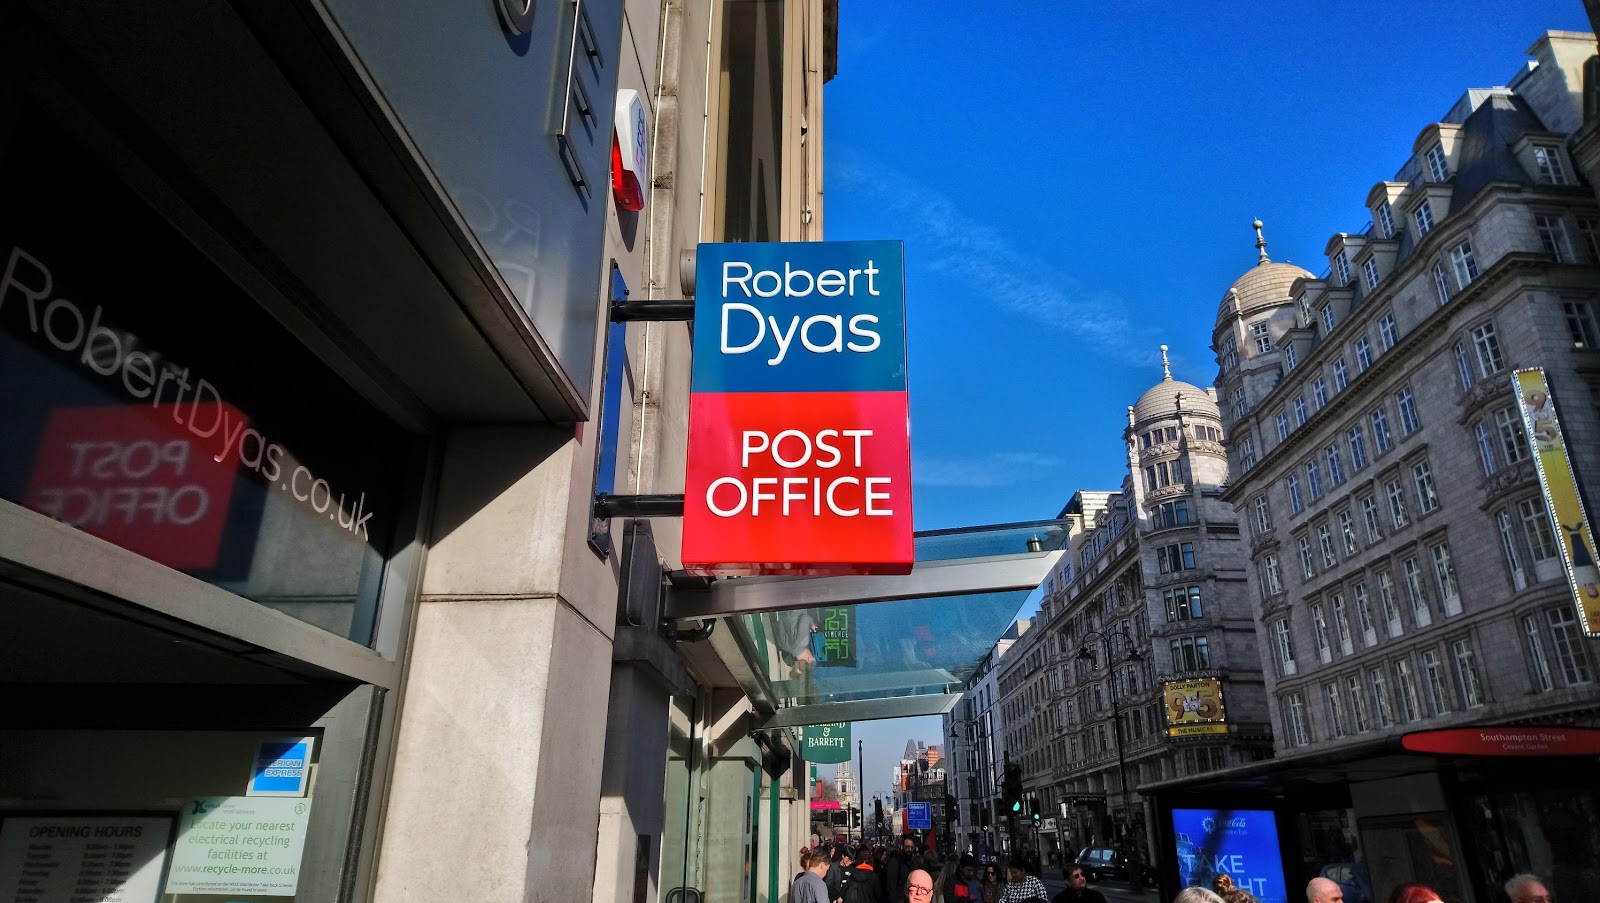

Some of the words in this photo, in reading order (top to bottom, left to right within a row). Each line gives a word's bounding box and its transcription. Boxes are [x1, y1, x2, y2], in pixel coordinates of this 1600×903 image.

[722, 260, 880, 298] Robert
[720, 303, 881, 366] Dyas
[0, 246, 373, 541] RobertDyas.co.uk
[741, 429, 873, 468] POST
[706, 476, 894, 517] OFFICE
[822, 727, 830, 737] &
[1480, 733, 1538, 742] Southampton
[1539, 733, 1567, 741] Street
[808, 737, 845, 748] BARRETT
[29, 826, 91, 838] OPENING
[94, 826, 143, 837] HOURS
[190, 819, 226, 830] Locate
[228, 821, 253, 832] your
[255, 821, 296, 831] nearest
[188, 835, 239, 845] electrical
[242, 836, 290, 848] recycling
[207, 849, 254, 860] facilities
[256, 851, 268, 860] at
[175, 864, 296, 875] www.recycle-more.co.uk
[1182, 855, 1245, 873] TAKE
